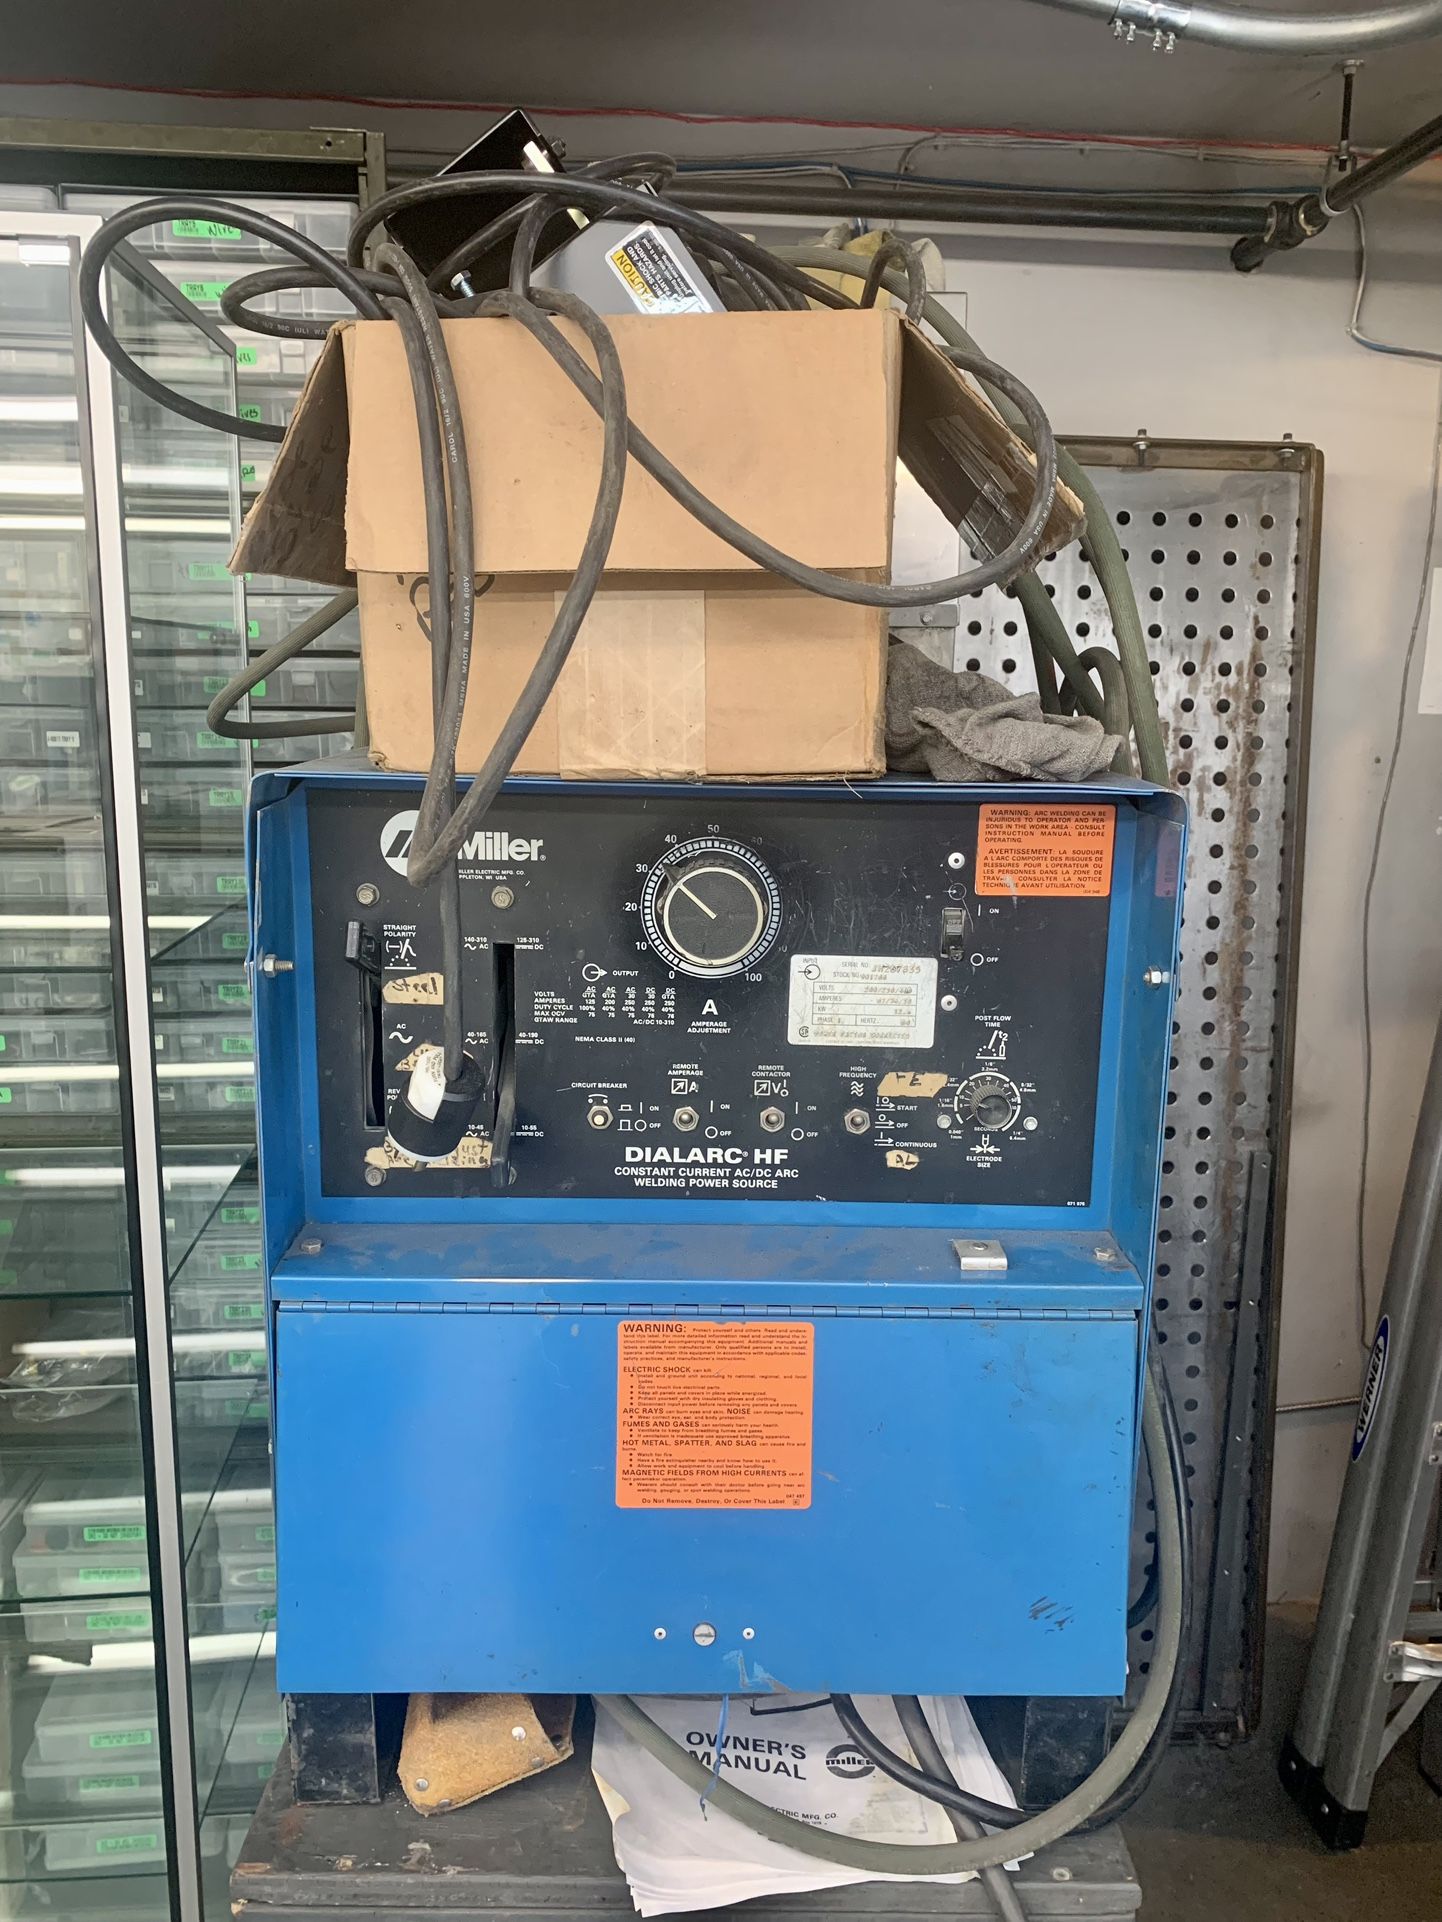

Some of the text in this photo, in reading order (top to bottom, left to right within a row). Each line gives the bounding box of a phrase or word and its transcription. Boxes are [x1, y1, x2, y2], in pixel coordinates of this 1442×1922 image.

[627, 246, 655, 284] SHOCK AND
[448, 432, 458, 463] CAROL
[1033, 521, 1044, 535] USA
[463, 605, 471, 624] USA
[464, 630, 470, 641] IN
[708, 825, 720, 833] 50
[665, 835, 676, 843] 40
[457, 831, 544, 861] Miller
[636, 864, 648, 872] 30
[625, 903, 637, 911] 20
[636, 942, 647, 950] 10
[669, 971, 675, 979] 0
[745, 973, 762, 982] 100
[701, 999, 718, 1016] A
[754, 1148, 789, 1164] HF
[614, 1167, 799, 1178] CONSTANT CURRENT AC/DC ARC
[634, 1178, 778, 1189] WELDING POWER SOURCE
[623, 1323, 687, 1333] WARNING:
[1357, 1344, 1383, 1433] WERNER
[686, 1731, 807, 1760] OWNER'S
[688, 1750, 807, 1781] MANUAL
